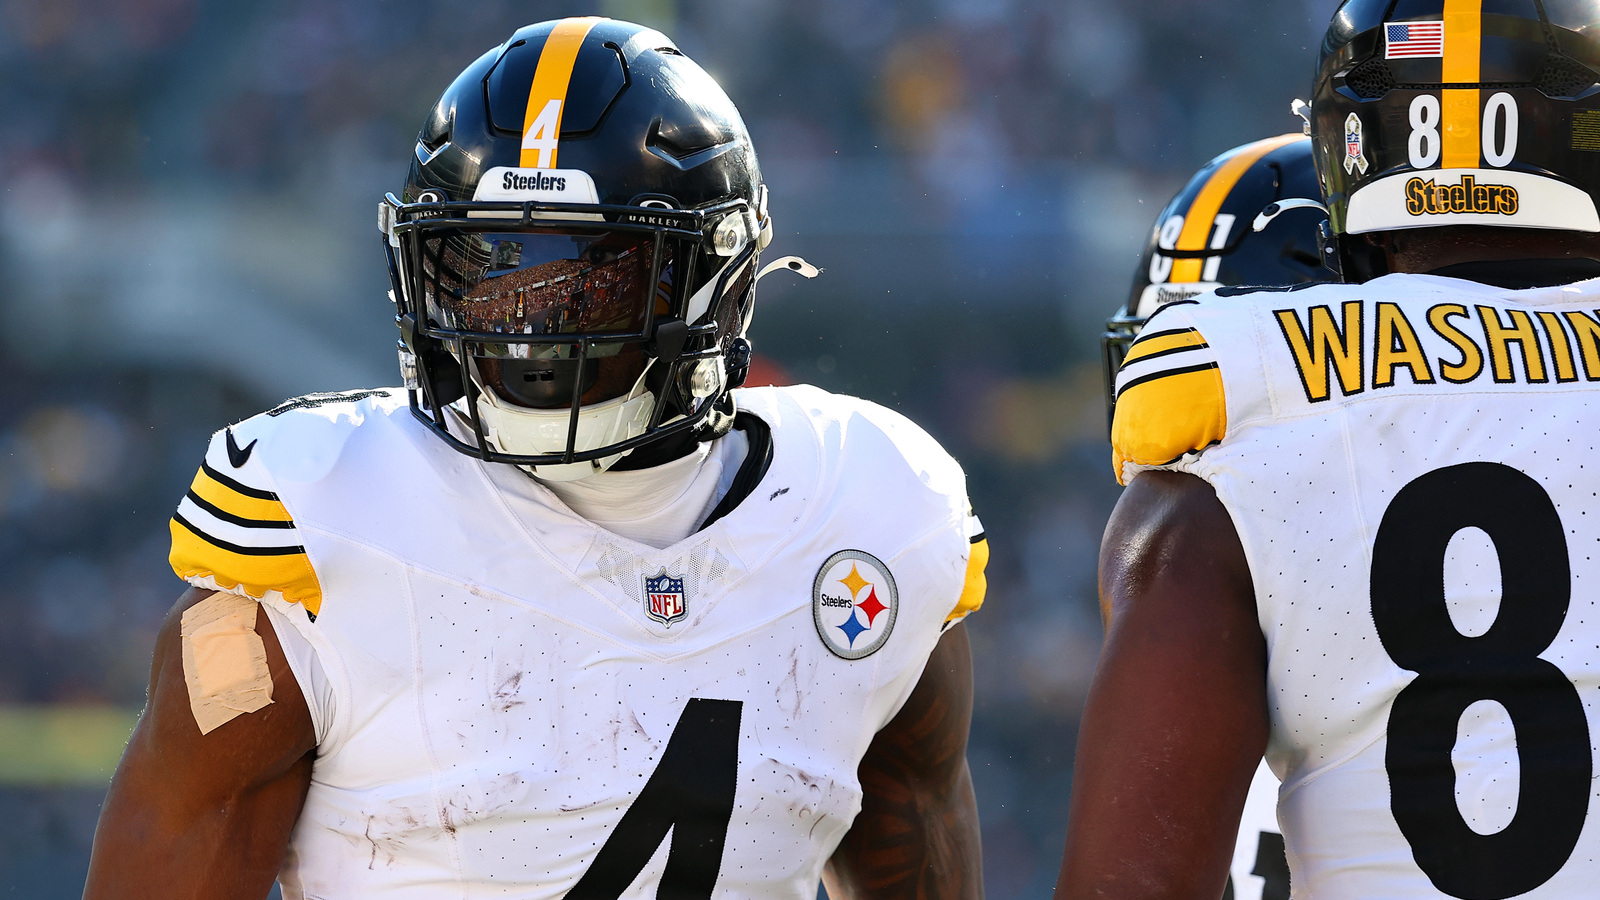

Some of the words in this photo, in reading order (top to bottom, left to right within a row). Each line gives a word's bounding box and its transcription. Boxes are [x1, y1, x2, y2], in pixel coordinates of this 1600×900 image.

[521, 99, 563, 168] 4
[1408, 92, 1519, 169] 80
[503, 171, 566, 191] Steelers
[1405, 174, 1519, 216] Steelers
[650, 594, 682, 618] NFL
[821, 593, 853, 609] Steelers
[1370, 461, 1592, 900] 8
[562, 697, 743, 900] 4
